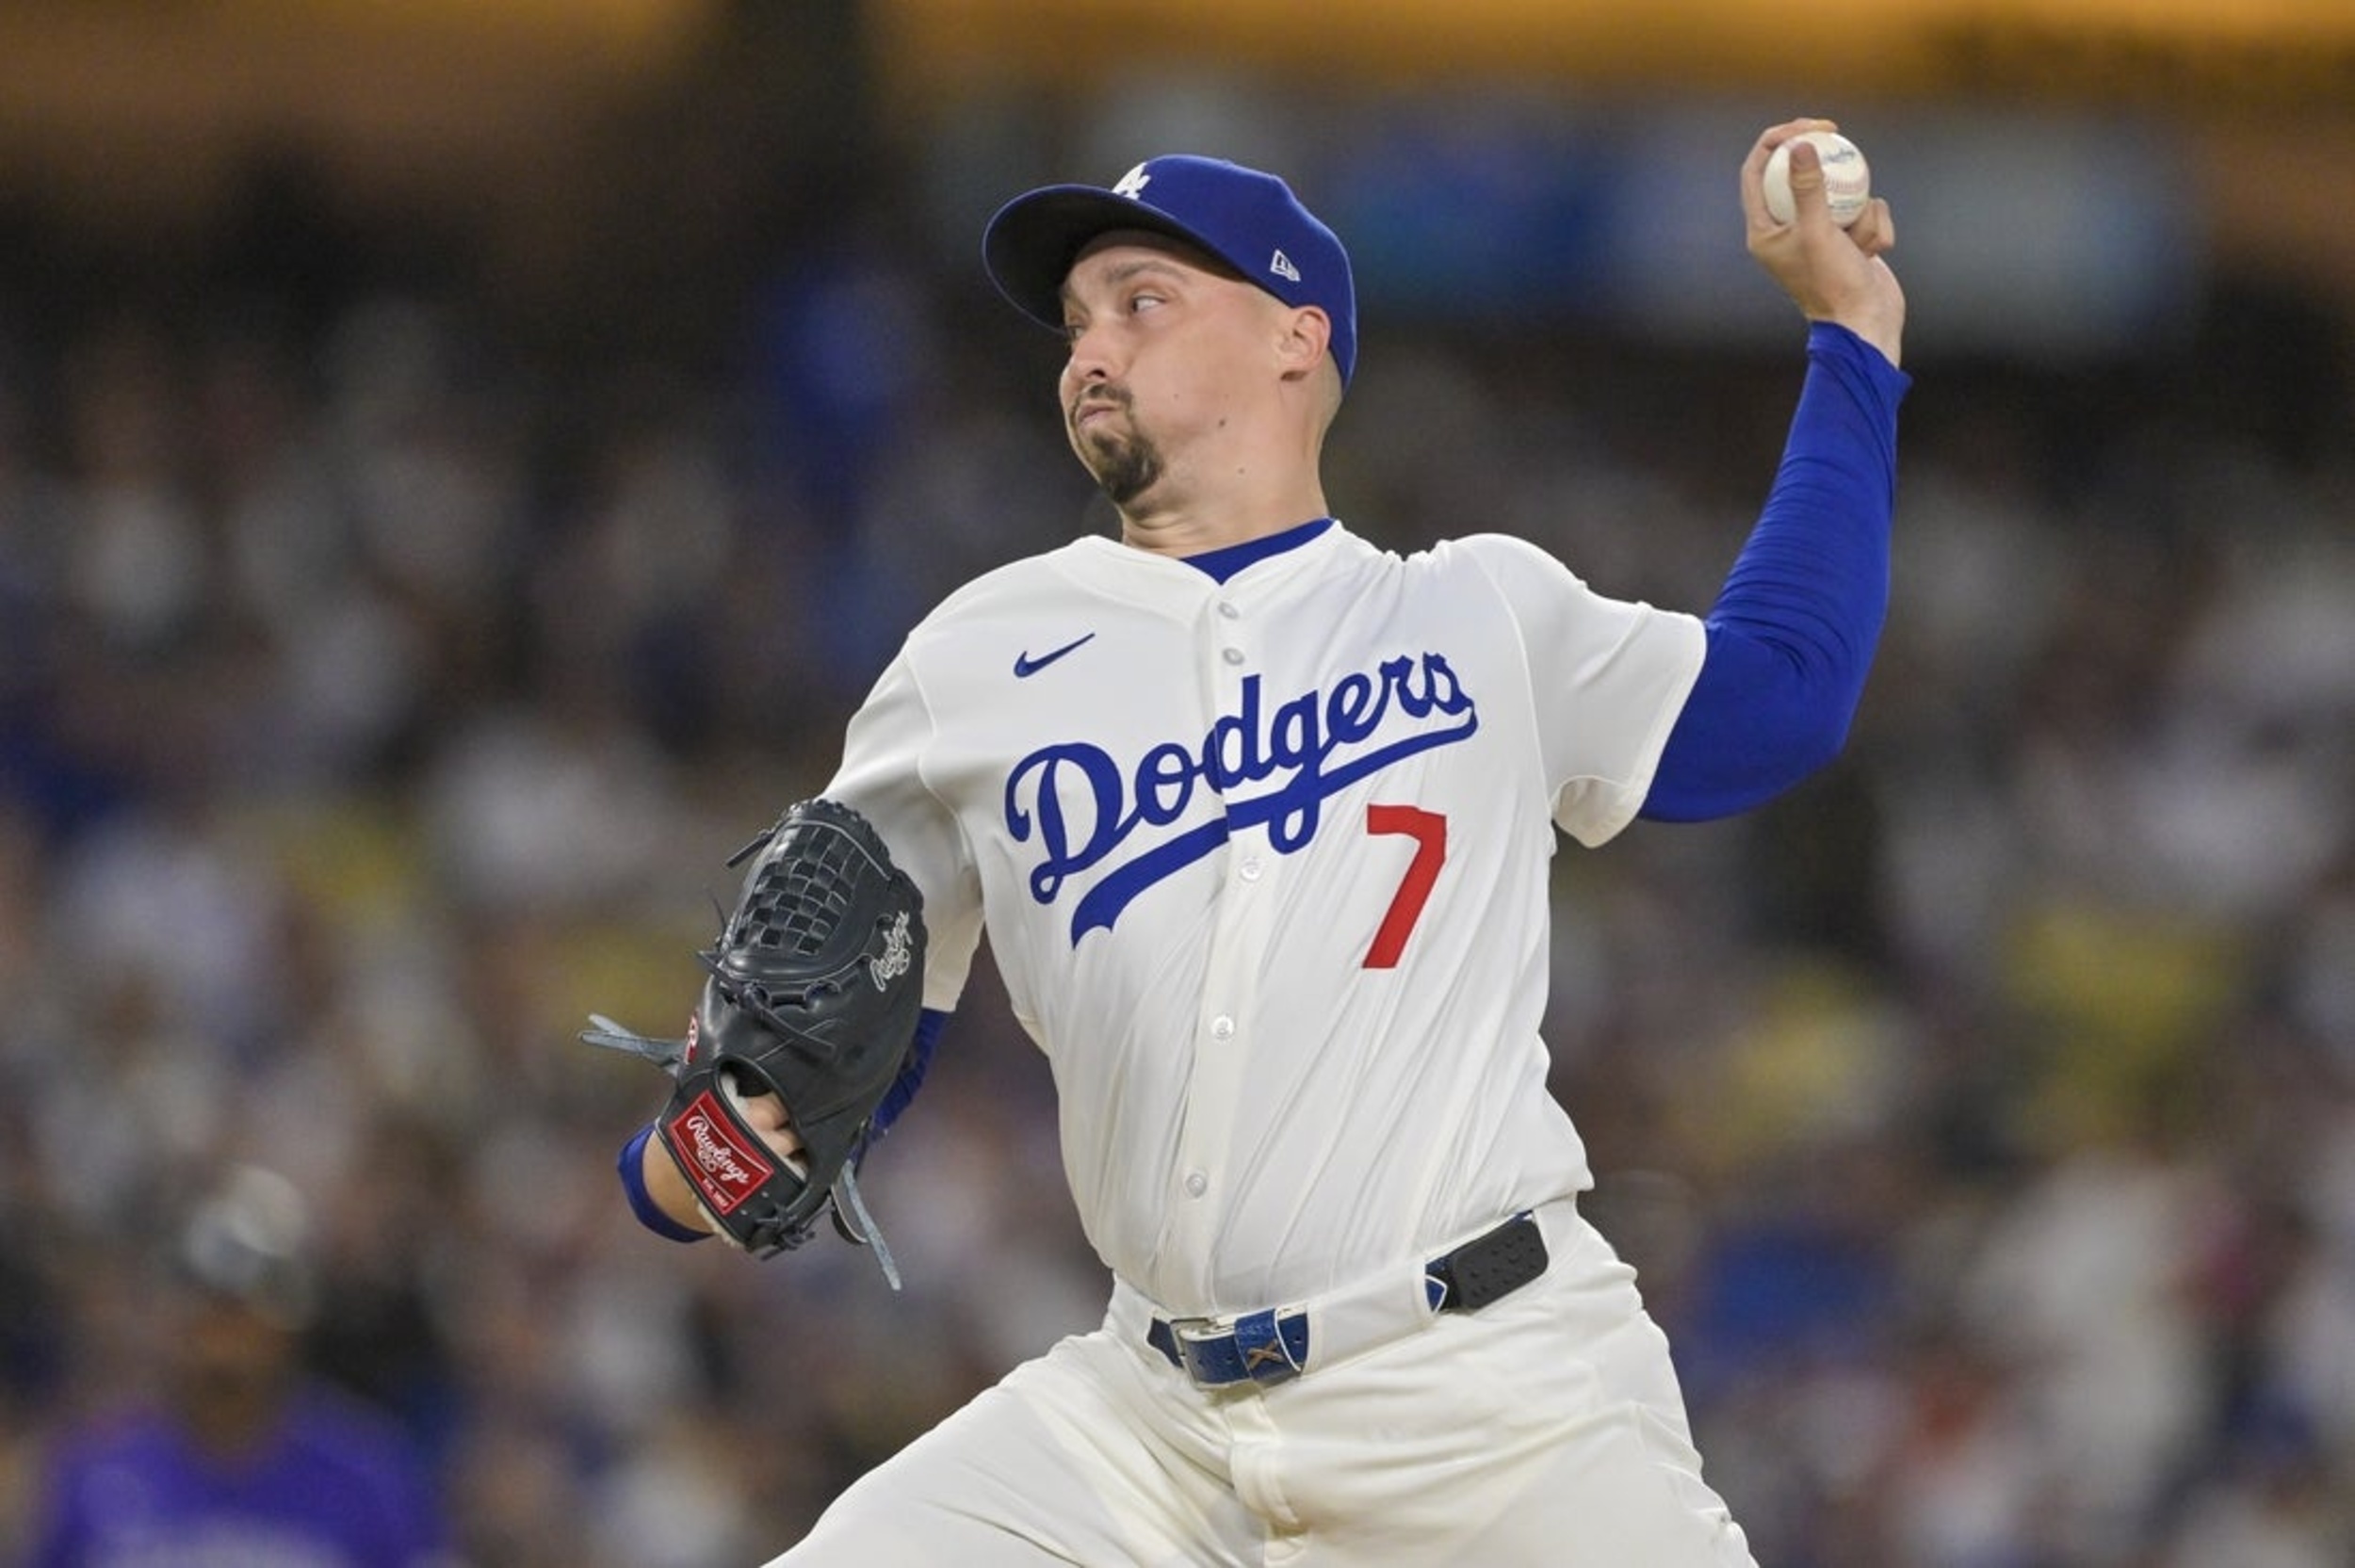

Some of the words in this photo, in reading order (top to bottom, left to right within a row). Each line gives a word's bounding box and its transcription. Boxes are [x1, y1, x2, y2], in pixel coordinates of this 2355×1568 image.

[1005, 652, 1477, 905] Dodgers
[1362, 803, 1447, 969] 7
[687, 1115, 750, 1185] Rawlings
